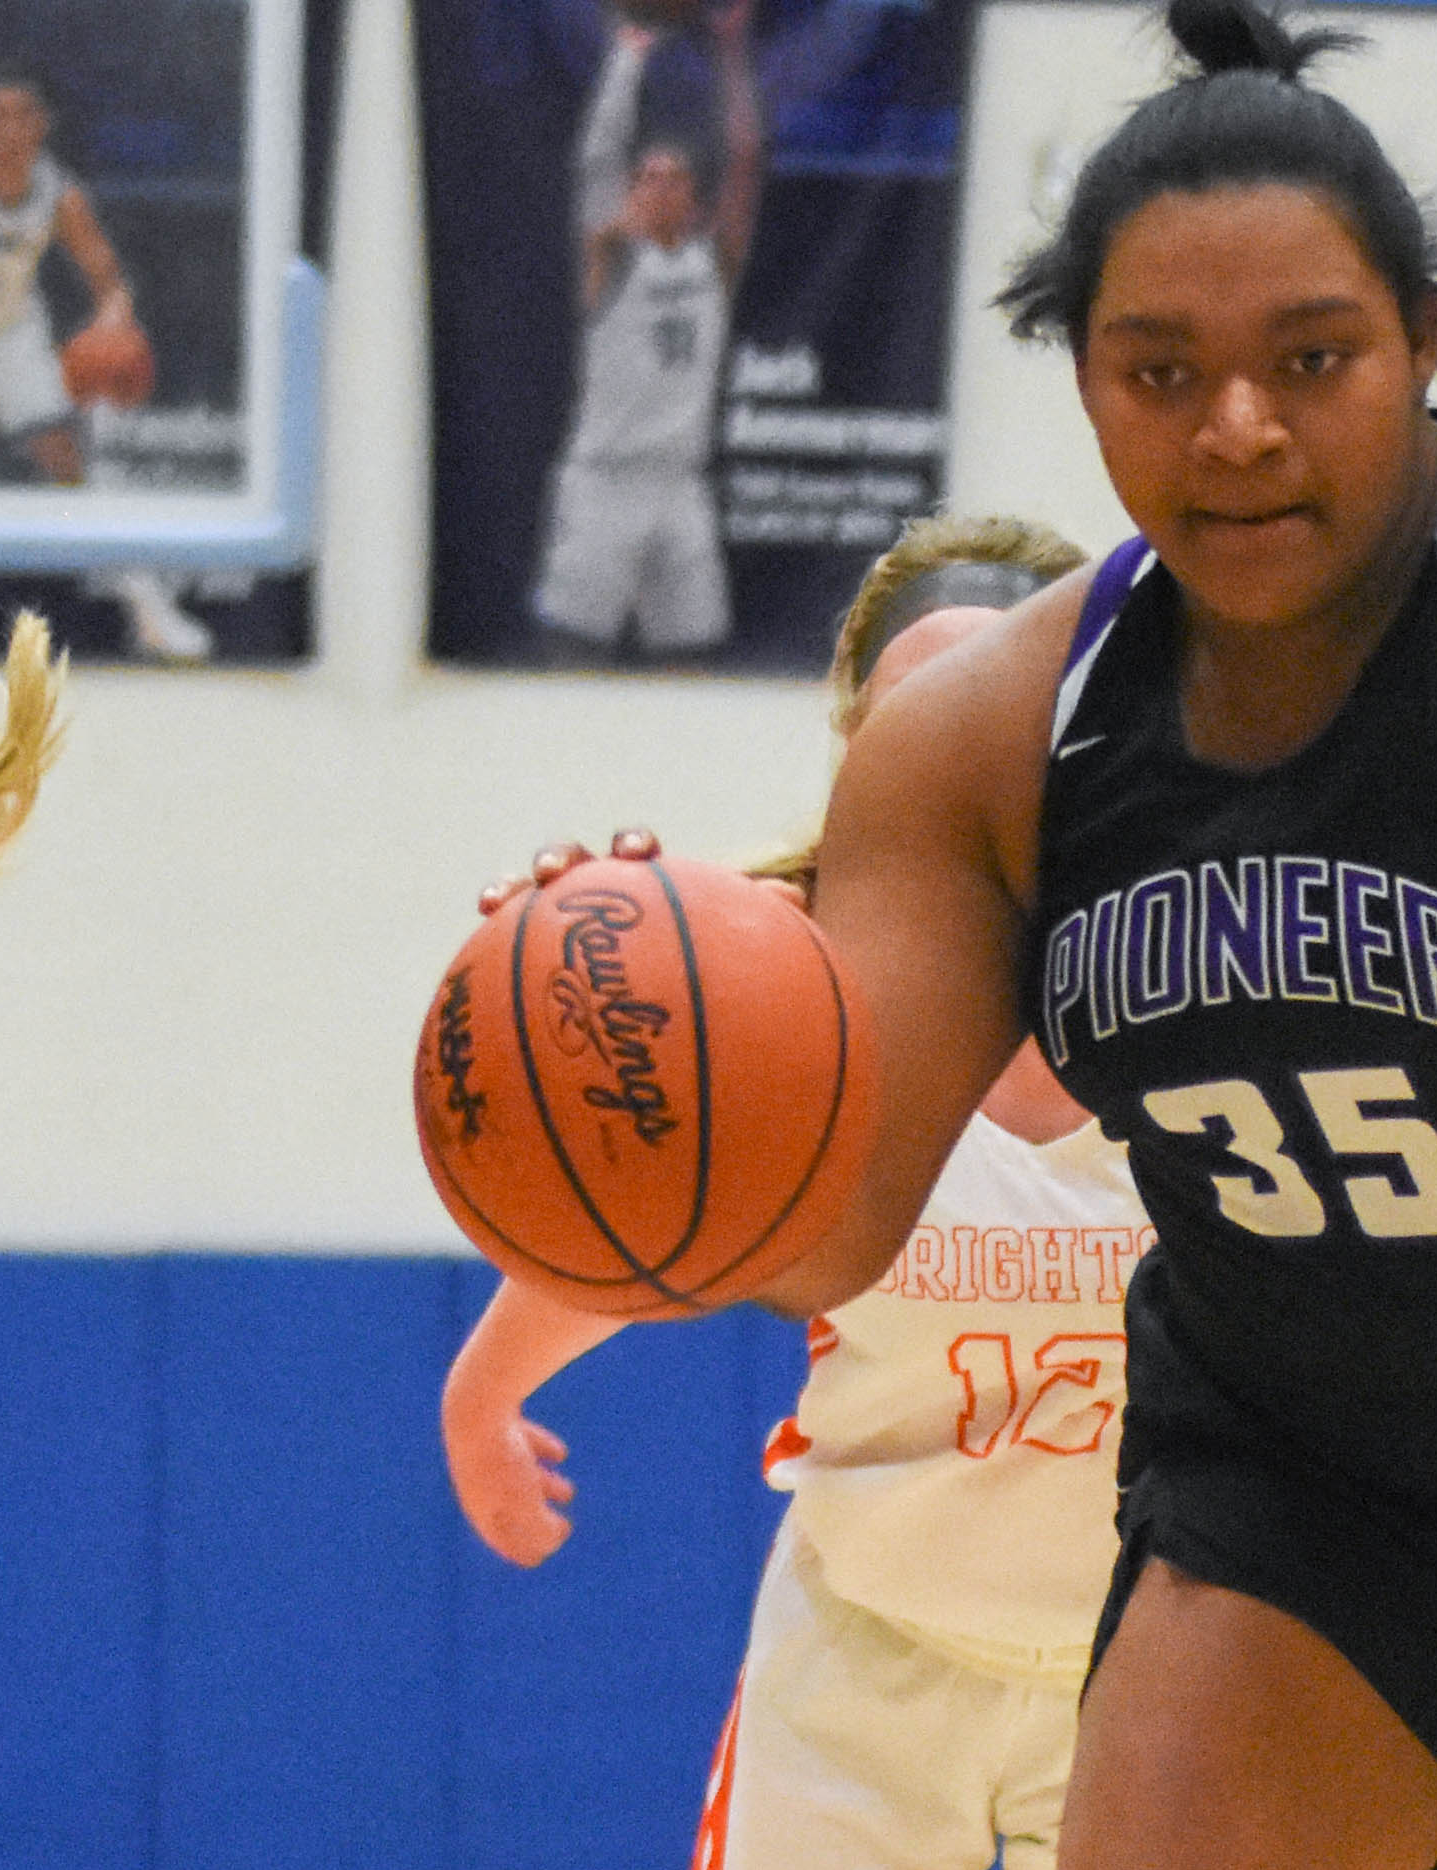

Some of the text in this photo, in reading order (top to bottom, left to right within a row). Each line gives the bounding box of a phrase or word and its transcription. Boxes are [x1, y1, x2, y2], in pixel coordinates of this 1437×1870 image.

[556, 888, 680, 1146] Rawlings
[874, 1224, 1160, 1305] RIGHT
[947, 1332, 1129, 1460] 12
